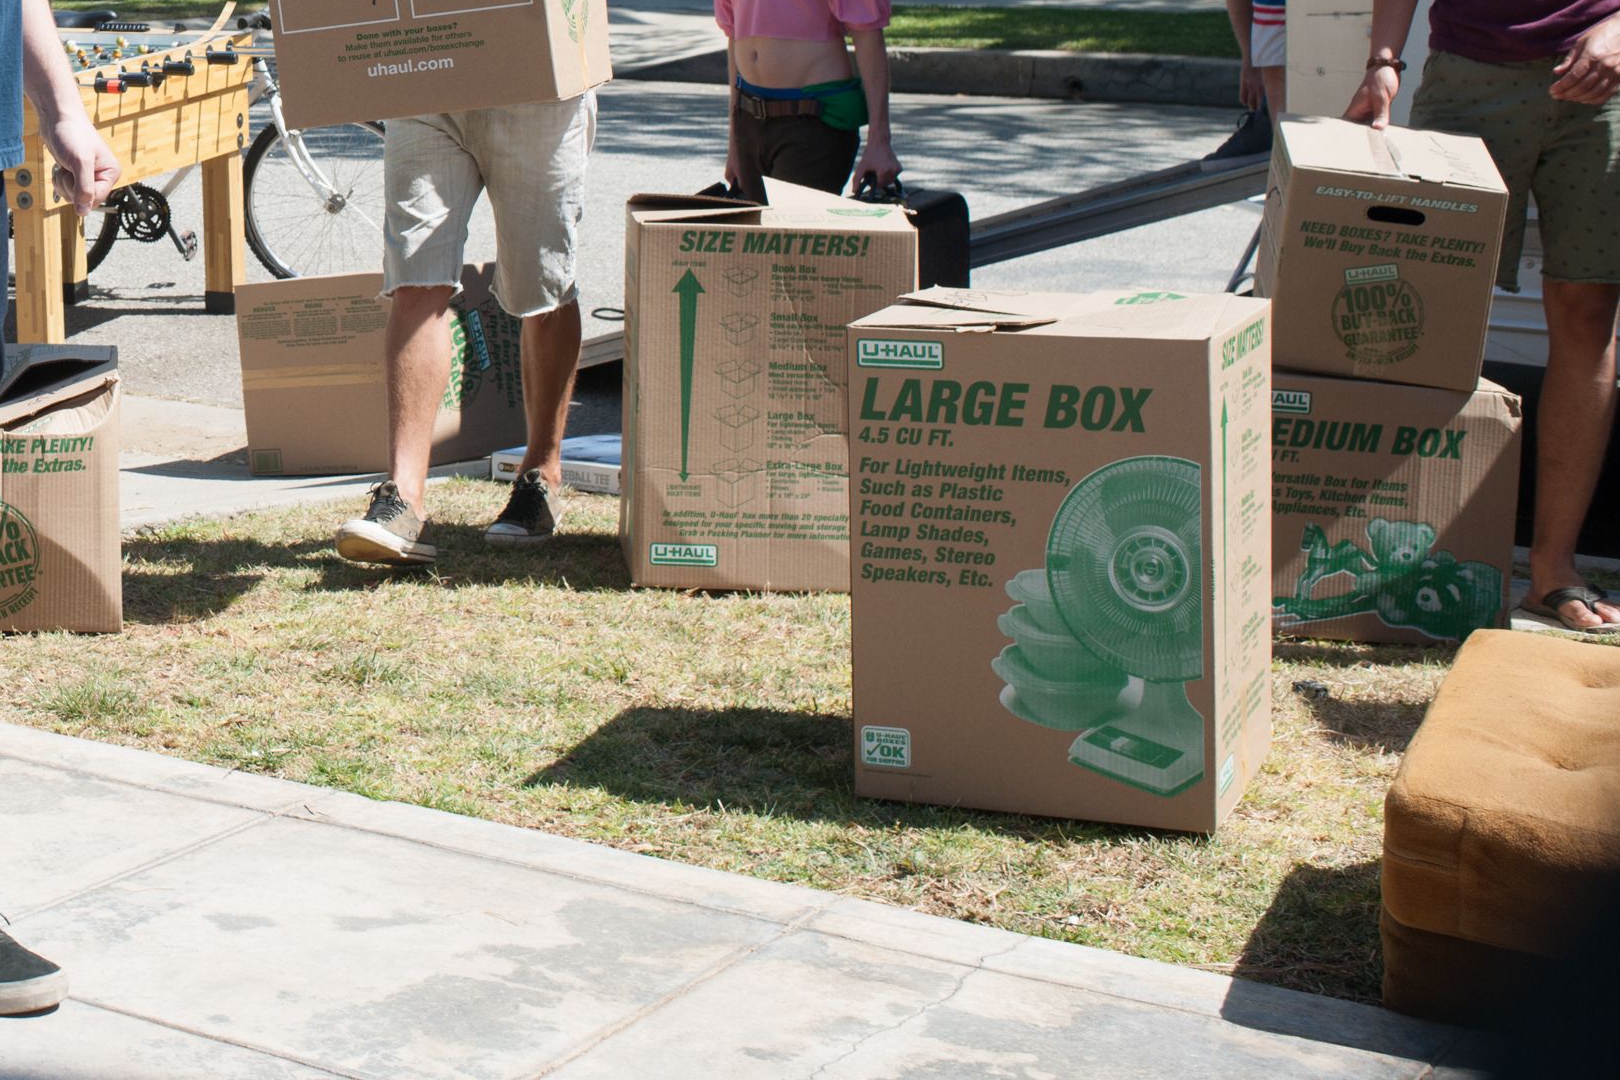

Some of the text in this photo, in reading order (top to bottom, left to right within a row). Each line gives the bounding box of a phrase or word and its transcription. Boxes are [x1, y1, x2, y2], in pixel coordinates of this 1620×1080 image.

[357, 22, 458, 41] Done with your boxes?
[345, 30, 473, 52] Make them available for others
[338, 55, 347, 63] to
[349, 52, 372, 61] reuse
[367, 56, 454, 77] uhaul.com
[1315, 185, 1478, 213] EASY-TO-LIFT HANDLES
[680, 230, 870, 257] SIZE MATTERS!
[1300, 221, 1486, 254] NEED BOXES? TAKE PLENTY!
[1304, 235, 1476, 268] We'll Buy Back the Extras.
[771, 264, 816, 274] Book Box
[1348, 266, 1395, 278] U-HAUL
[1340, 283, 1411, 313] 100%
[770, 312, 796, 322] Small
[862, 343, 938, 359] U-HAUL
[1222, 334, 1236, 371] SIZE
[768, 362, 807, 370] Medium
[859, 377, 1030, 427] LARGE
[1043, 384, 1154, 433] BOX
[1271, 392, 1308, 405] AUL
[767, 411, 815, 421] Large Box
[31, 436, 94, 454] PLENTY!
[858, 426, 954, 447] 4.5 CU FT.
[1271, 417, 1467, 460] EDIUM BOX
[766, 460, 843, 471] Extra-Large Box
[1280, 450, 1299, 463] FT.
[2, 458, 87, 474] the Extras.
[859, 456, 1070, 487] For Lightweight Items,
[594, 473, 611, 486] TEE
[1324, 475, 1408, 492] Box for Items
[859, 478, 905, 496] Such
[911, 483, 933, 498] as
[939, 482, 1003, 501] Plastic
[1285, 487, 1408, 509] Toys, Kitchen Items,
[672, 511, 706, 519] addition,
[801, 513, 811, 521] 20
[859, 499, 1017, 527] Food Containers,
[1344, 505, 1368, 518] Etc.
[663, 520, 700, 529] designed
[701, 520, 713, 528] for
[817, 524, 846, 533] storage
[679, 529, 697, 537] Grab
[707, 530, 739, 539] Packing
[740, 530, 772, 539] Planner
[860, 520, 989, 547] Lamp Shades,
[654, 546, 714, 558] U-HAUL
[861, 542, 995, 566] Games, Stereo
[861, 563, 993, 587] Speakers, Etc.
[7, 586, 39, 615] RECEIPT
[879, 745, 905, 758] OK
